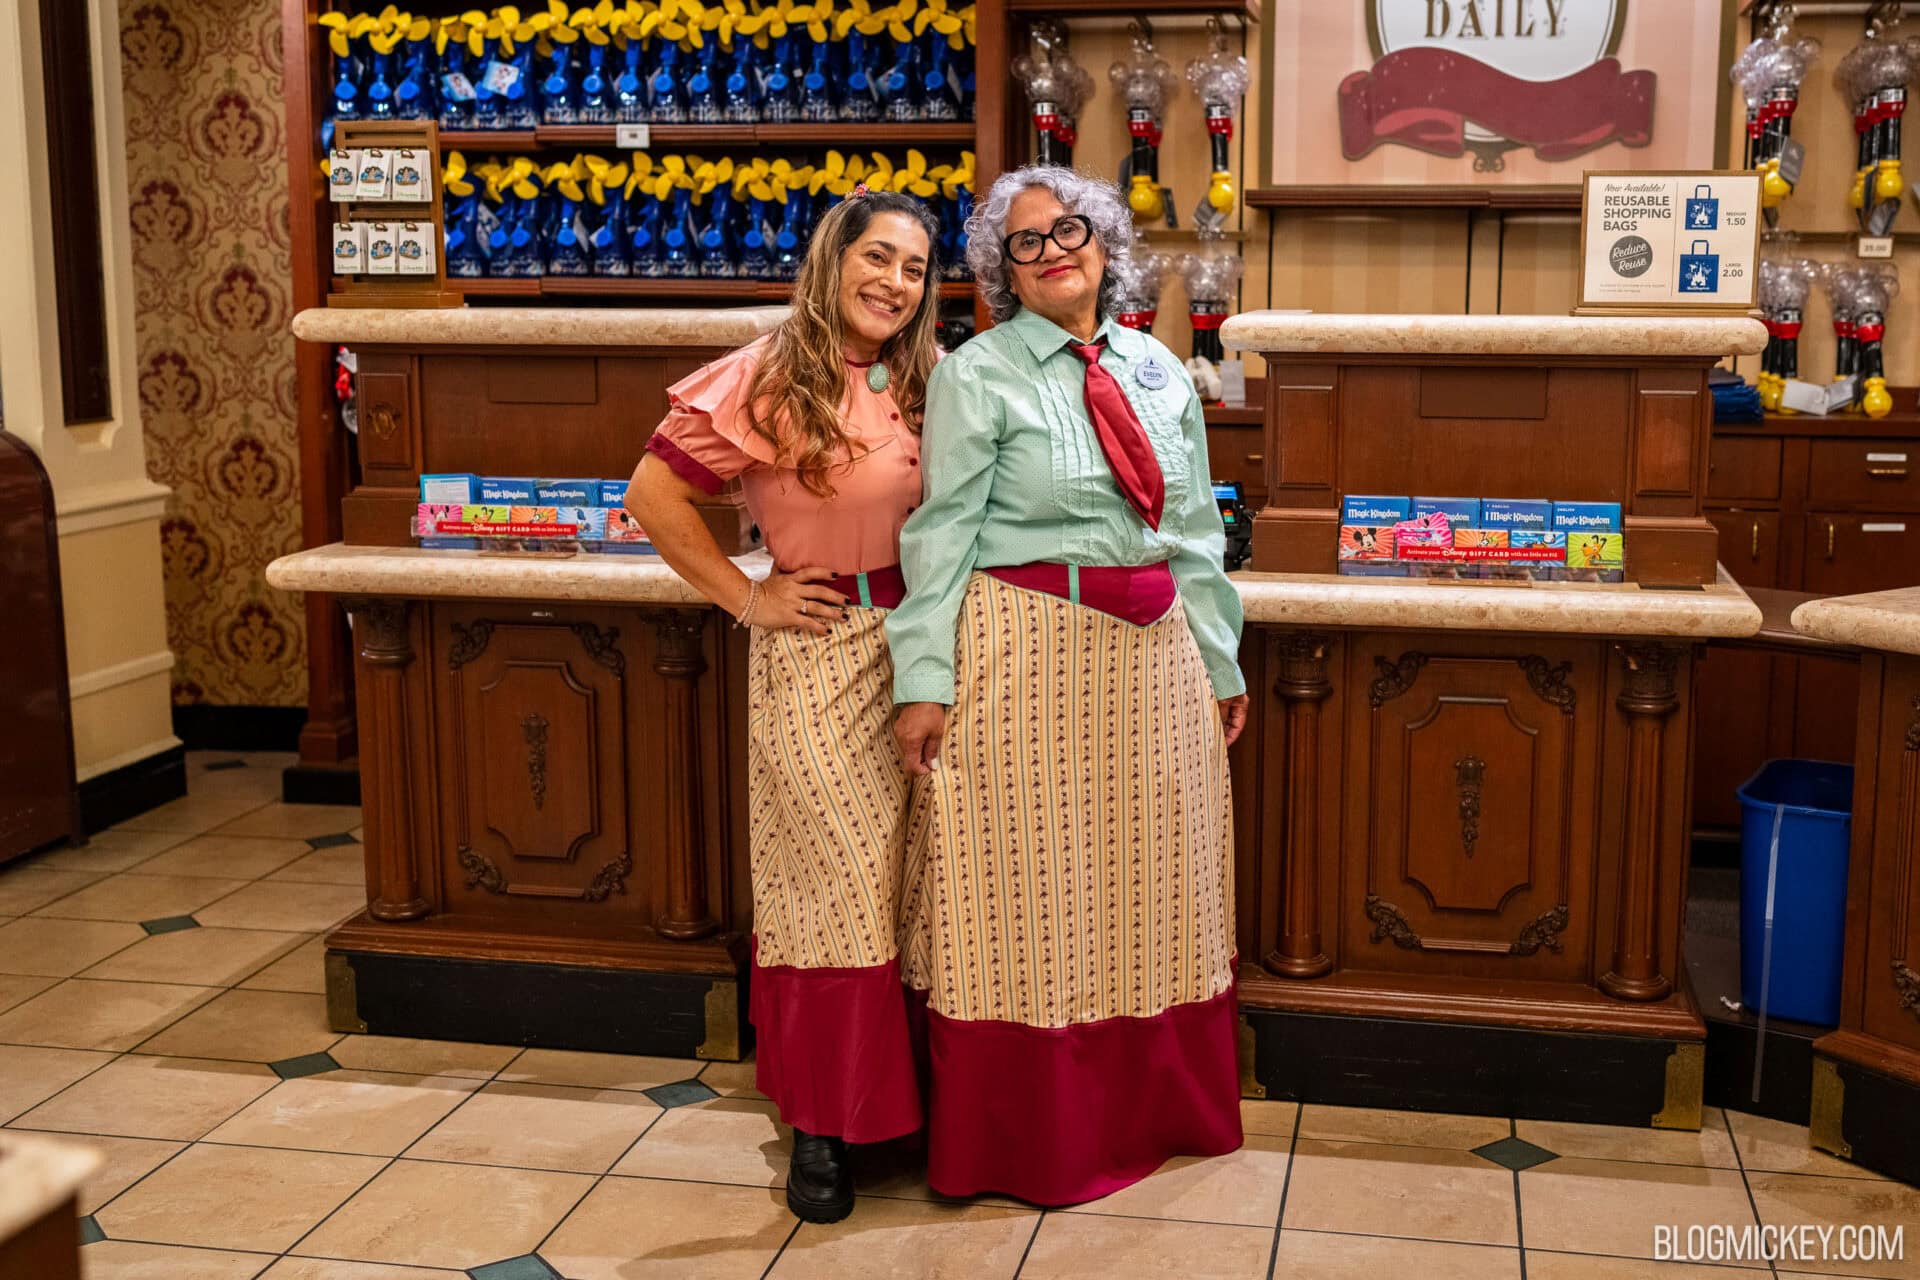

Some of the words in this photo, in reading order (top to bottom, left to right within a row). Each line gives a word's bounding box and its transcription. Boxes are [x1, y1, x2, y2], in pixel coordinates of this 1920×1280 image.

[1424, 0, 1564, 37] DAILY
[1604, 183, 1623, 193] Now
[1624, 183, 1665, 192] Available!
[1604, 195, 1670, 206] REUSABLE
[1603, 208, 1672, 218] SHOPPING
[1603, 220, 1638, 231] BAGS
[1726, 217, 1746, 226] 1.50
[1612, 242, 1648, 259] Reduce
[1618, 257, 1648, 273] Reuse
[1722, 269, 1744, 278] 2.00
[483, 489, 502, 499] Magic
[503, 489, 529, 500] Kingdom
[602, 491, 623, 502] Magic
[1348, 508, 1369, 519] Magic
[1370, 508, 1401, 519] Kingdom
[1490, 511, 1512, 522] Magic
[1513, 511, 1544, 523] Kingdom
[1556, 515, 1578, 526] Magic
[1579, 515, 1610, 526] Kingdom
[471, 522, 494, 534] Disney
[1440, 546, 1468, 559] Disney
